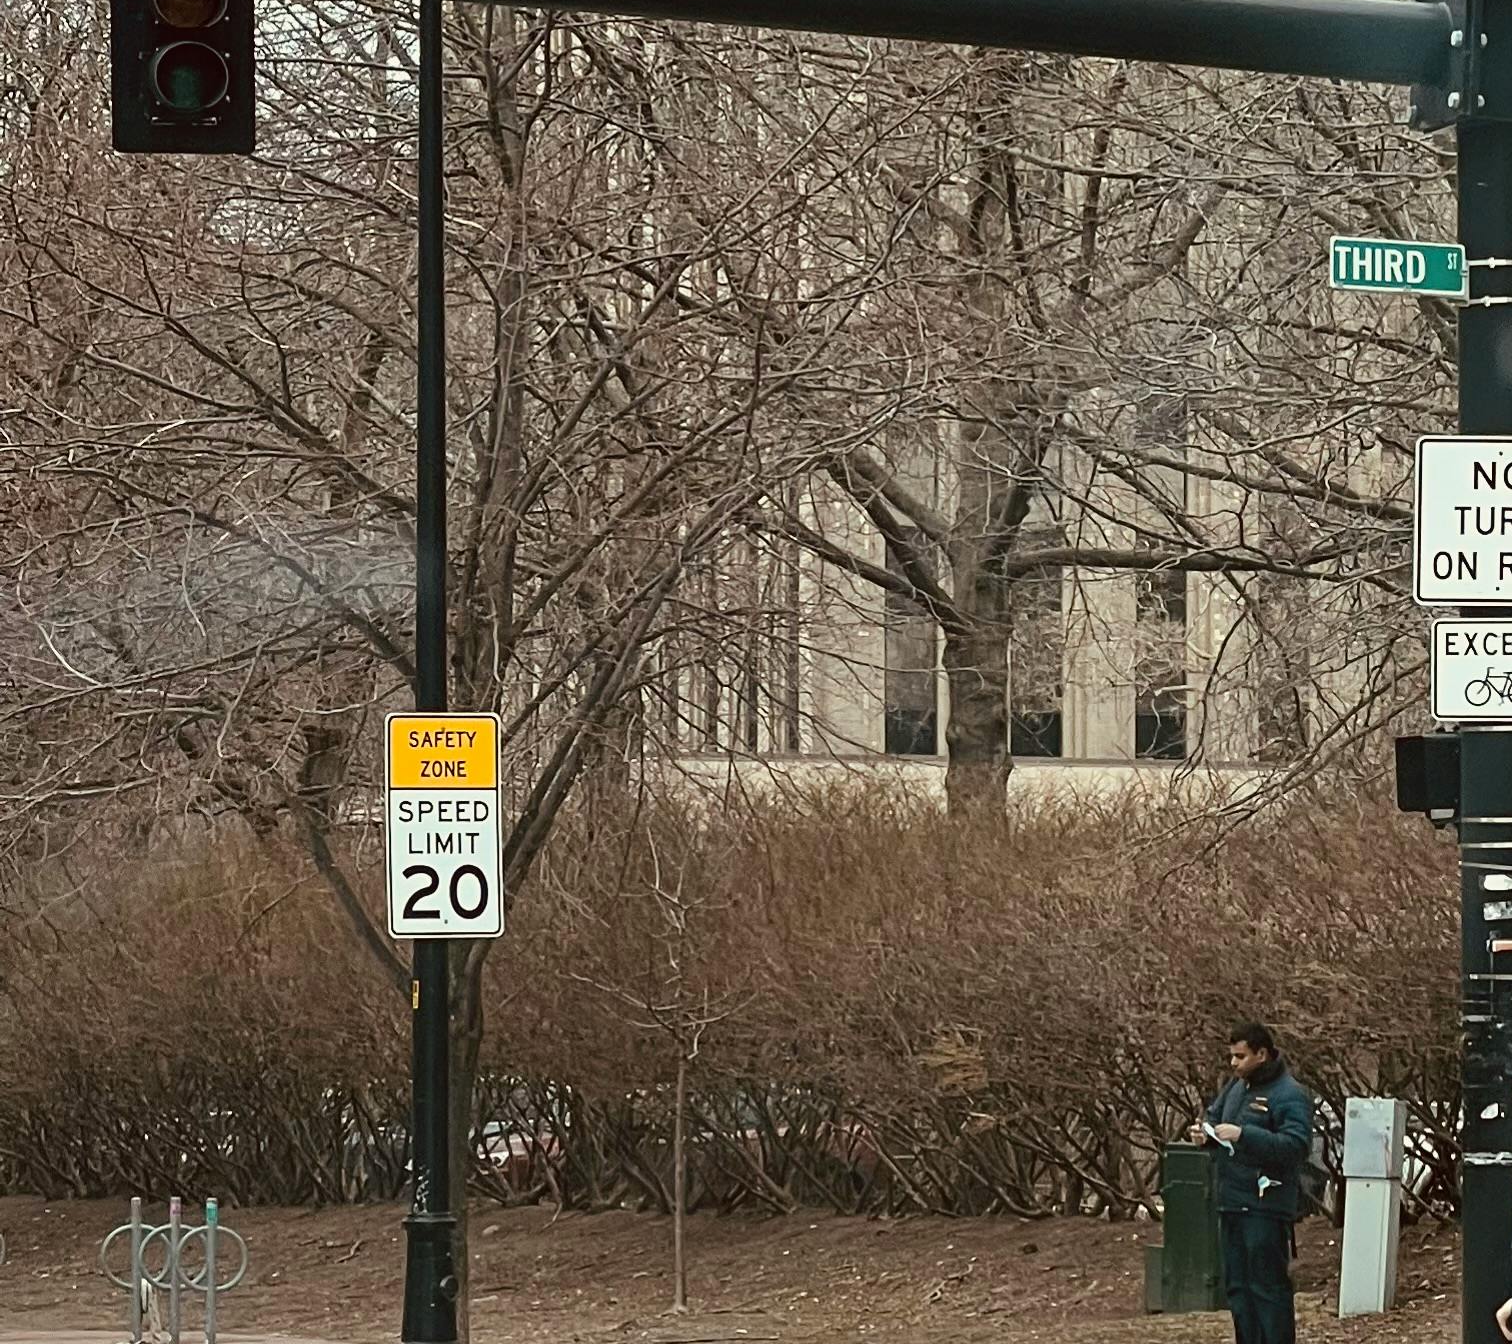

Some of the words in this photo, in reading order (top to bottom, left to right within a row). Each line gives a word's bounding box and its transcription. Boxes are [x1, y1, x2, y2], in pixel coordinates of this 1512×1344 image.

[1334, 245, 1426, 284] THIRD
[1447, 252, 1458, 270] ST
[1432, 552, 1478, 581] ON
[408, 731, 477, 748] SAFETY
[420, 760, 467, 778] ZONE
[398, 800, 489, 823] SPEED
[408, 832, 480, 855] LIMIT
[402, 864, 489, 920] 20
